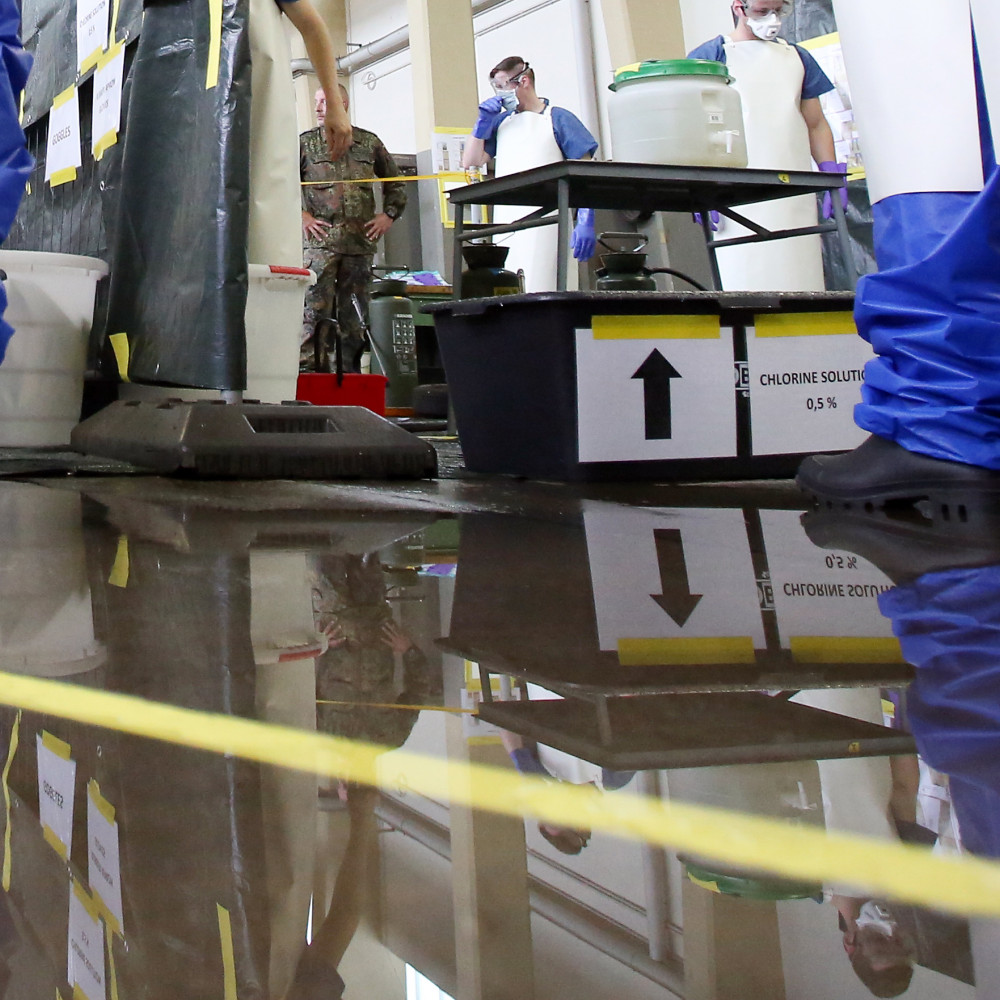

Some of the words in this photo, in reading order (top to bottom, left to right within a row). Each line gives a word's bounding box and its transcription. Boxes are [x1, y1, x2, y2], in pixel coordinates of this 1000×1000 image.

[759, 371, 818, 386] CHLORINE
[821, 369, 865, 383] SOLUTI
[806, 397, 824, 411] 0,5
[827, 396, 837, 409] %
